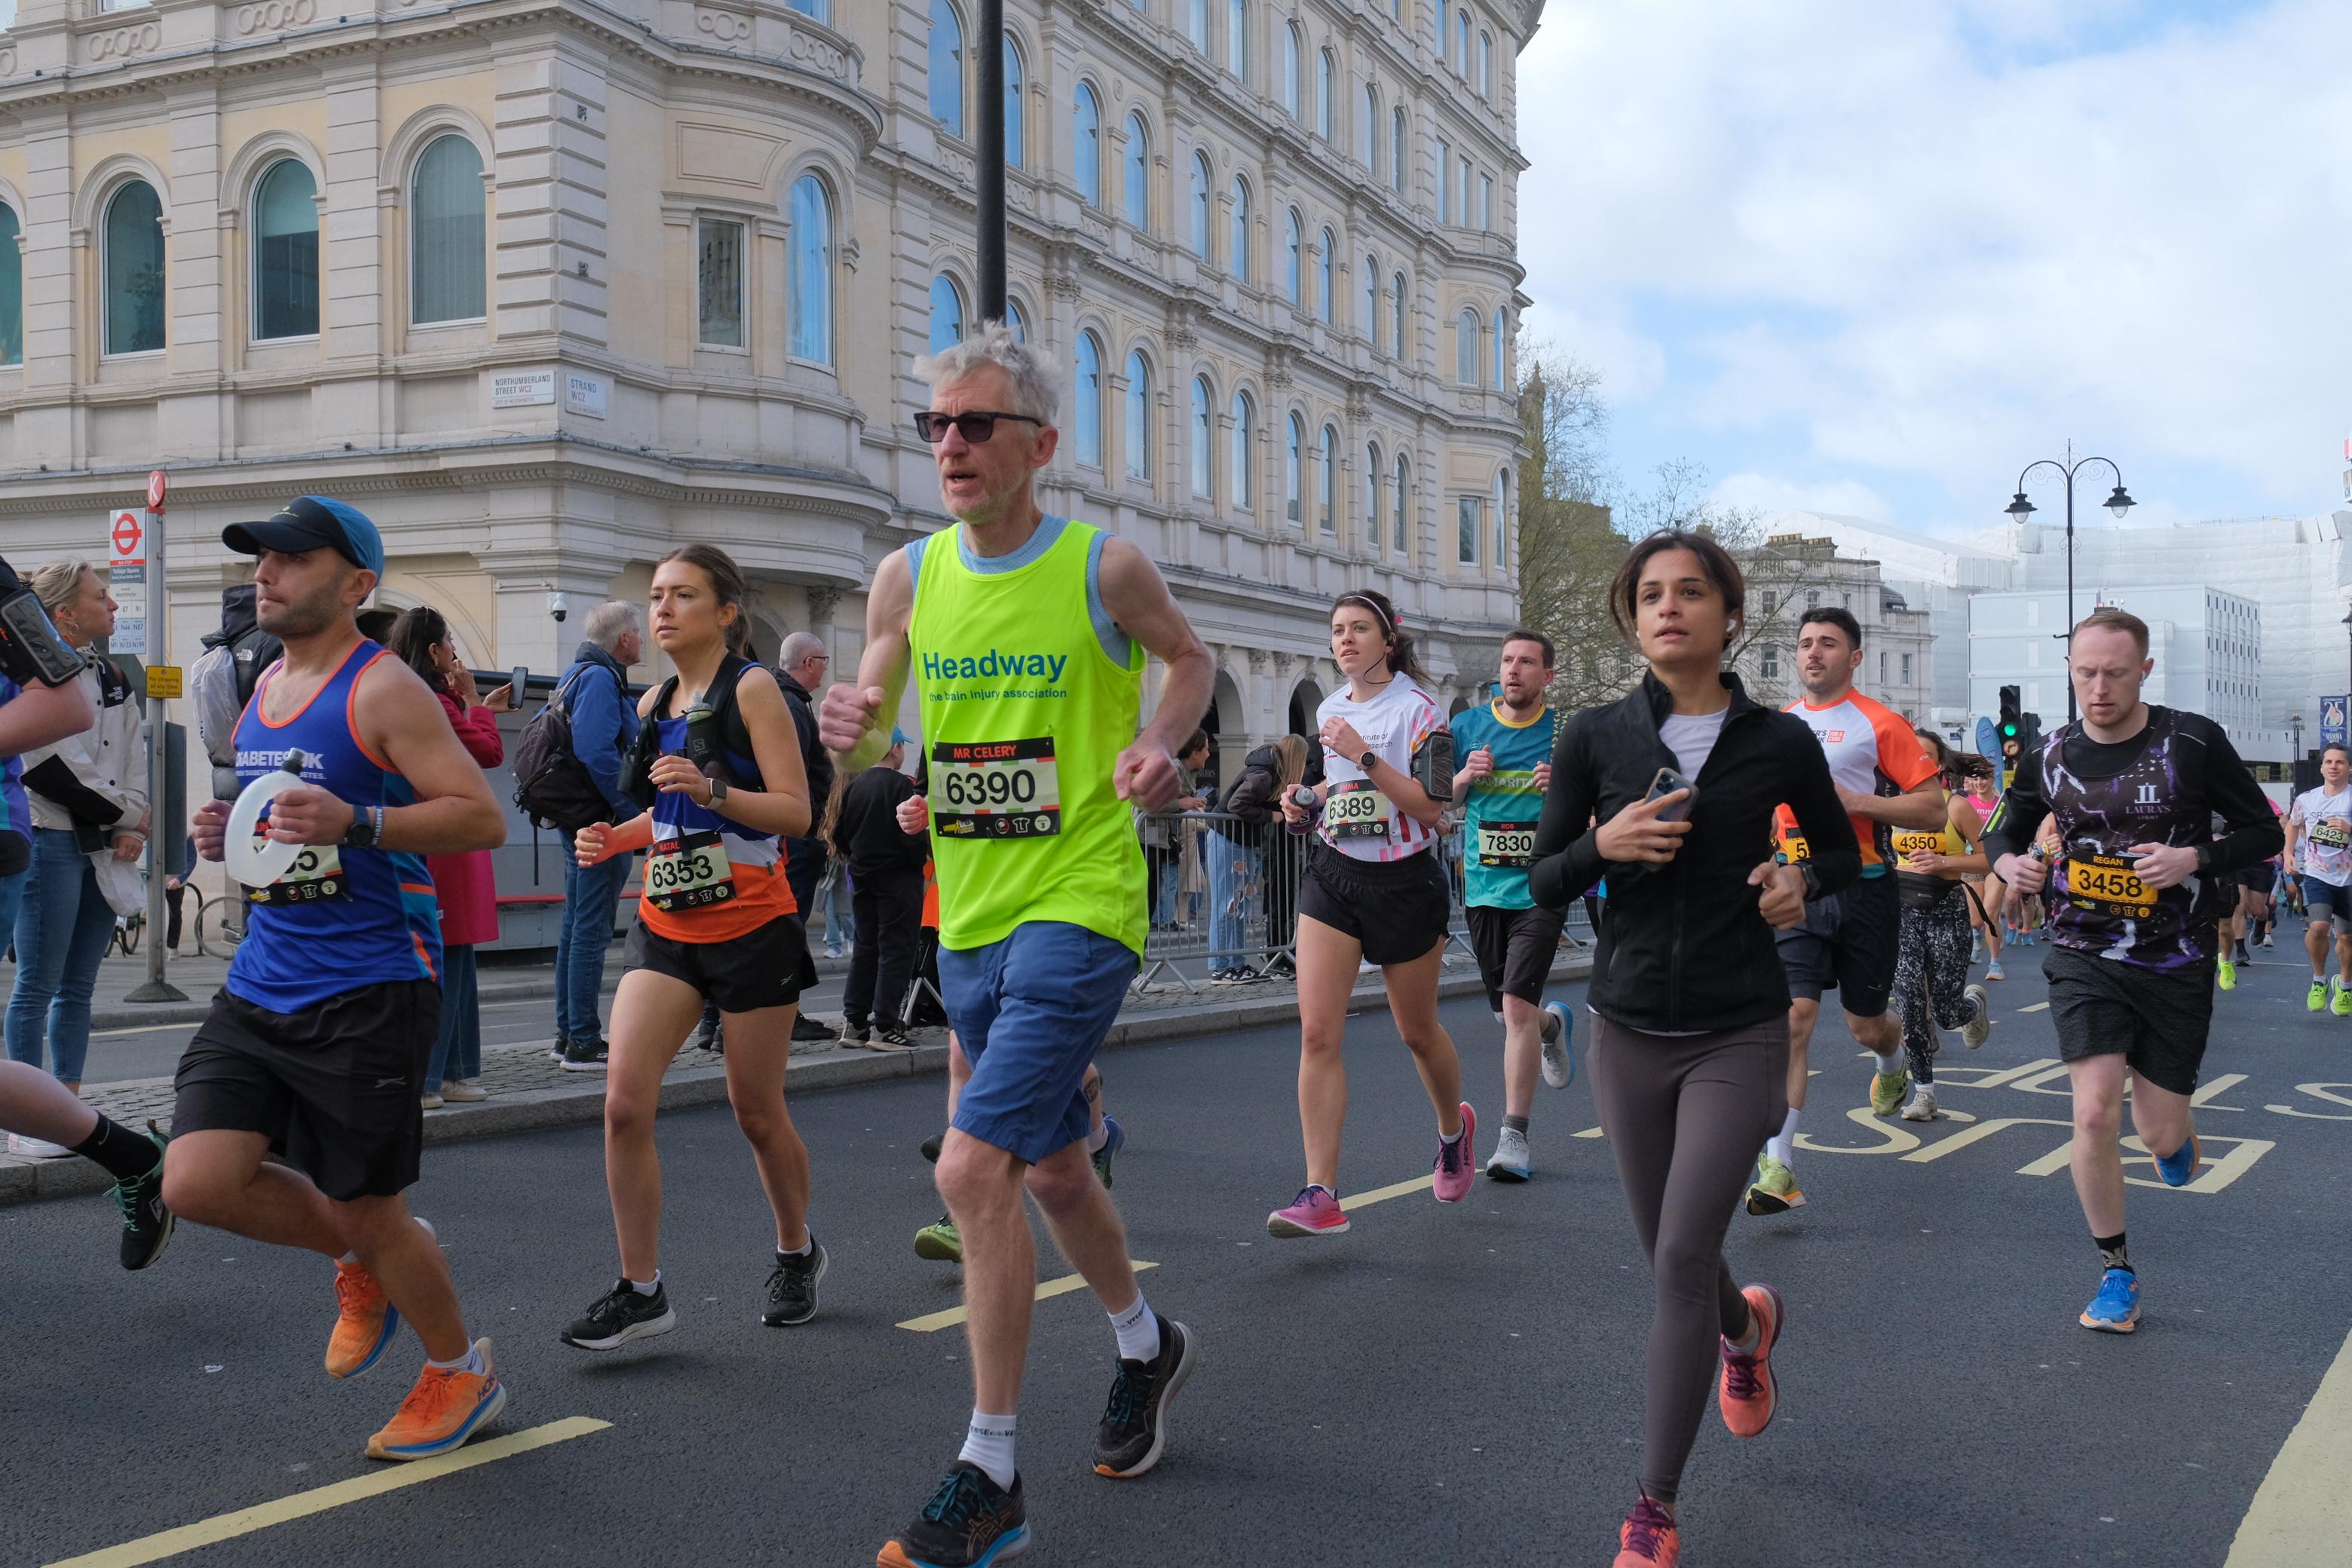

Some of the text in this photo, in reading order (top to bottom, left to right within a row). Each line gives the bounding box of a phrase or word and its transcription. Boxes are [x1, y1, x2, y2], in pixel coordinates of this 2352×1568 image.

[495, 375, 551, 386] NORTHUMBERLAND
[571, 379, 597, 393] STRAND
[495, 387, 516, 395] STREET
[571, 391, 586, 403] WC2
[150, 476, 159, 501] K
[923, 649, 1067, 684] Headway
[929, 688, 1067, 702] the brain injury association
[954, 745, 1017, 758] MR CELERY
[946, 770, 1036, 805] 6390
[1477, 777, 1533, 788] SAMARITA
[1329, 796, 1376, 820] 6389
[2126, 805, 2171, 814] LAURA'S
[2316, 827, 2344, 841] 6423
[659, 842, 680, 852] NATAL
[1486, 835, 1532, 852] 7830
[1900, 836, 1937, 850] 4350
[2093, 856, 2124, 866] REGAN
[652, 855, 713, 888] 6353
[2078, 869, 2142, 898] 3458
